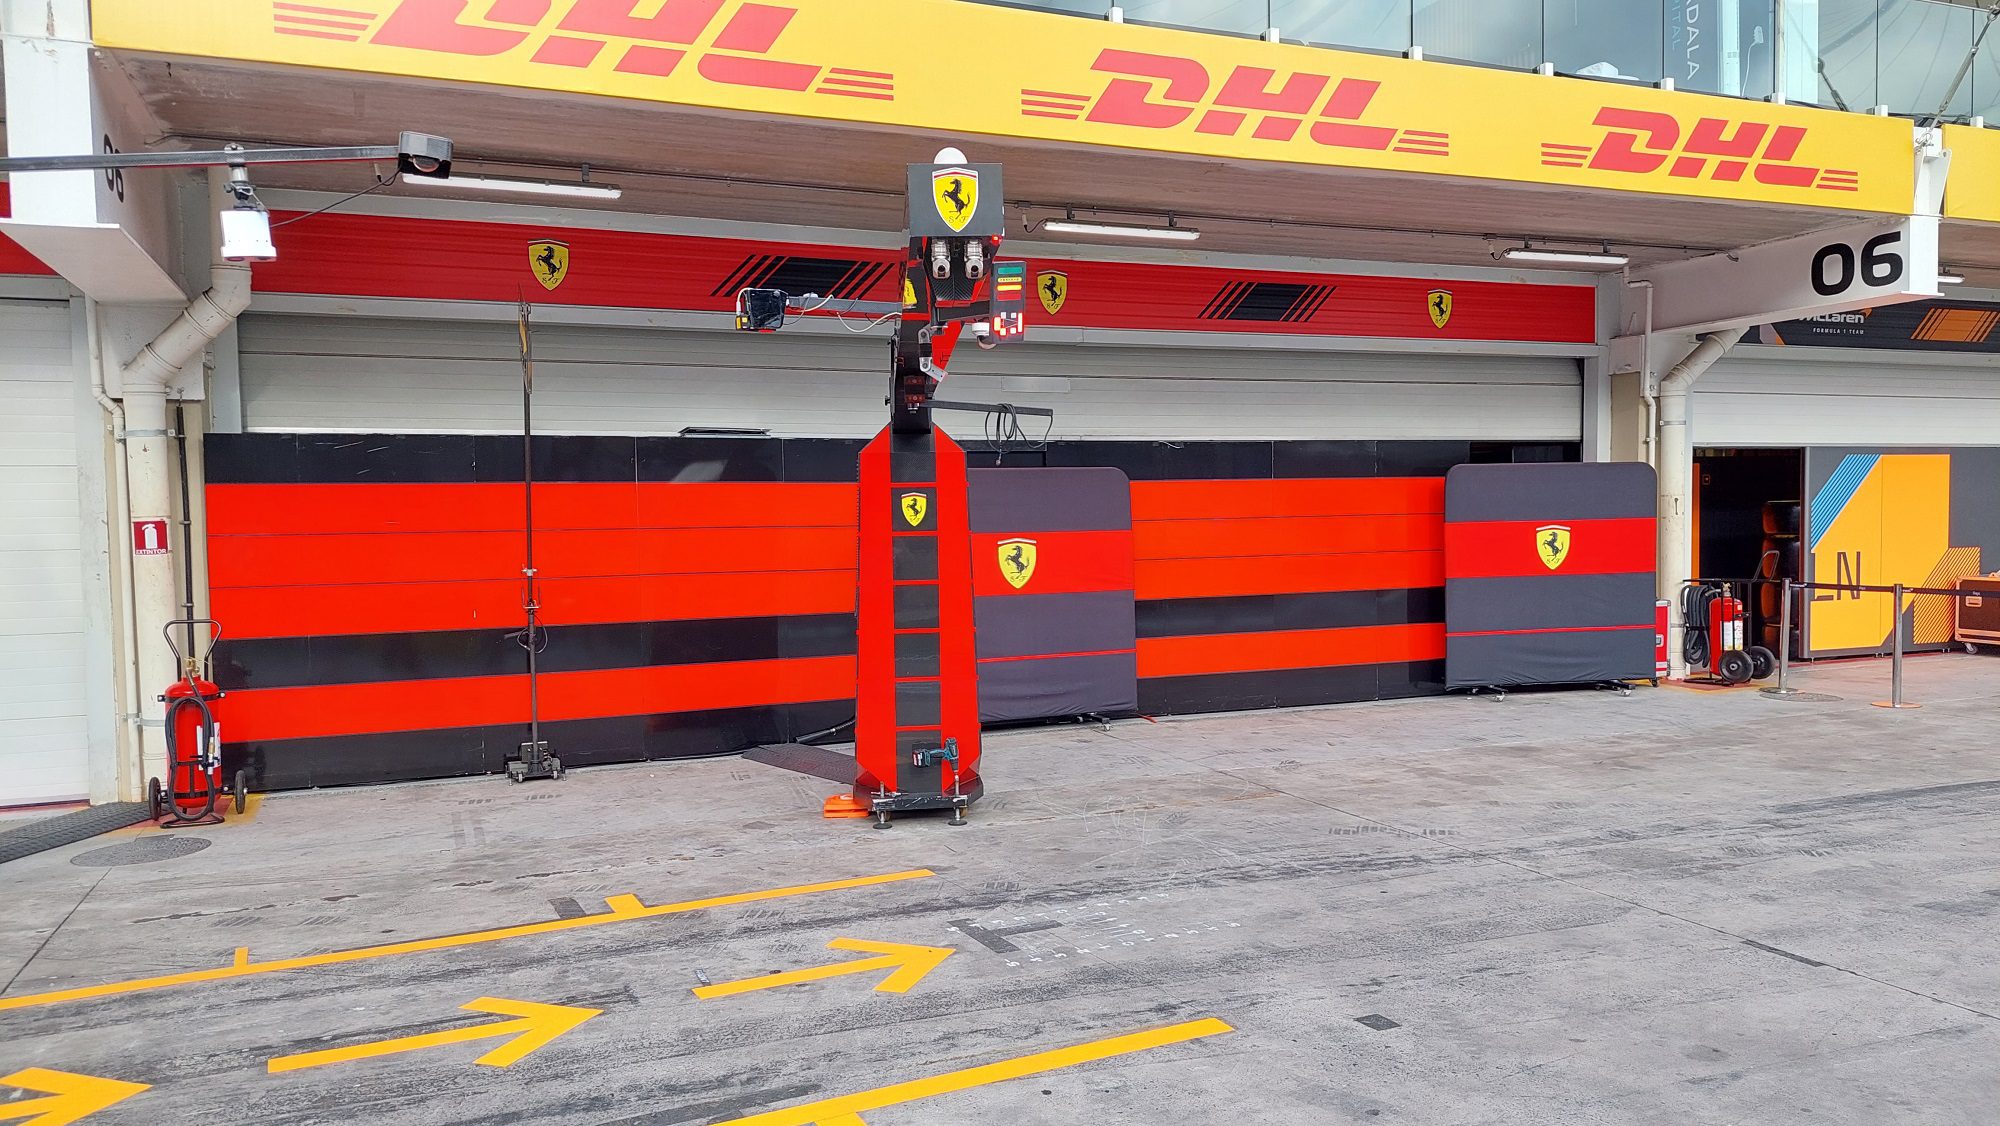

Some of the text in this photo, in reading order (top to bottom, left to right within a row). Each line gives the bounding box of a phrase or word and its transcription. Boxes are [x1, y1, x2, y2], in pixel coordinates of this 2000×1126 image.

[369, 0, 823, 92] DHL
[1671, 0, 1681, 51] ITAL
[1686, 0, 1700, 80] DALA
[1085, 48, 1399, 151] DHL
[1587, 106, 1819, 188] DHL
[1810, 231, 1904, 296] 06
[1813, 327, 1840, 335] FORMULA
